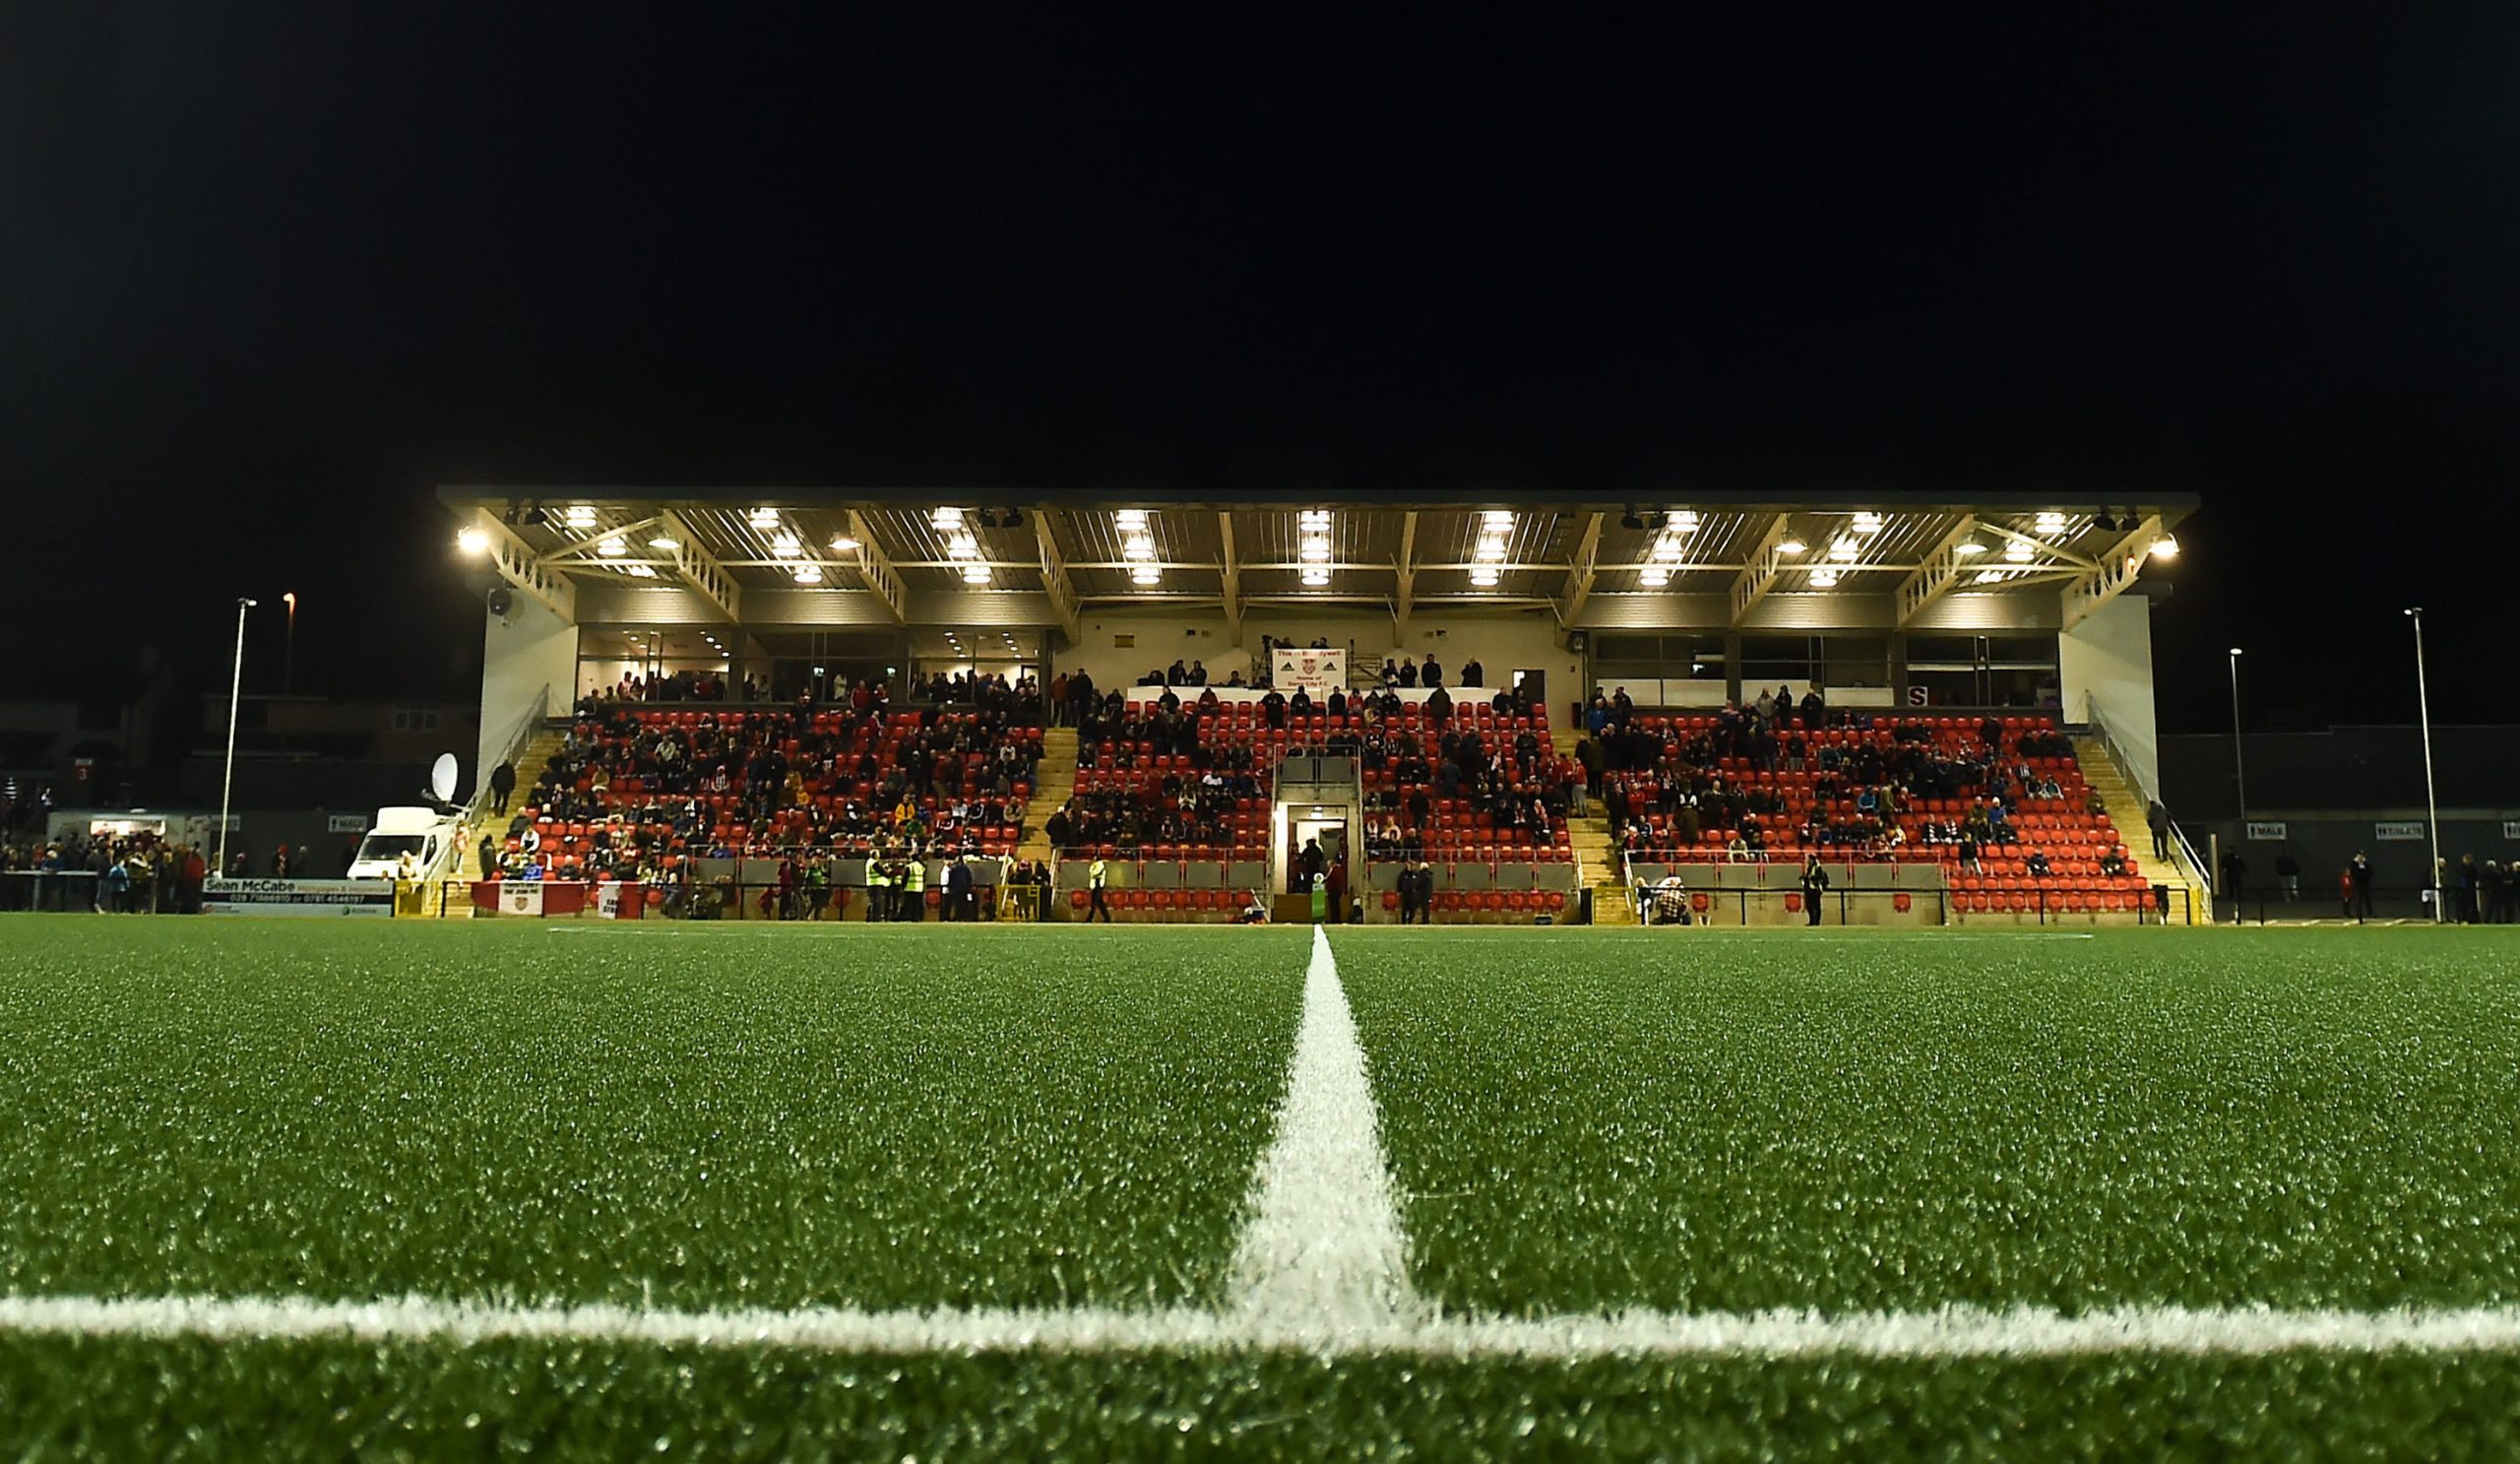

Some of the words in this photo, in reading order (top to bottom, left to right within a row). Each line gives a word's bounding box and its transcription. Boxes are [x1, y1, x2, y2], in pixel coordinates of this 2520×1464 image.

[1910, 688, 1925, 705] S
[206, 879, 238, 891] Sean
[242, 880, 295, 892] McCabe
